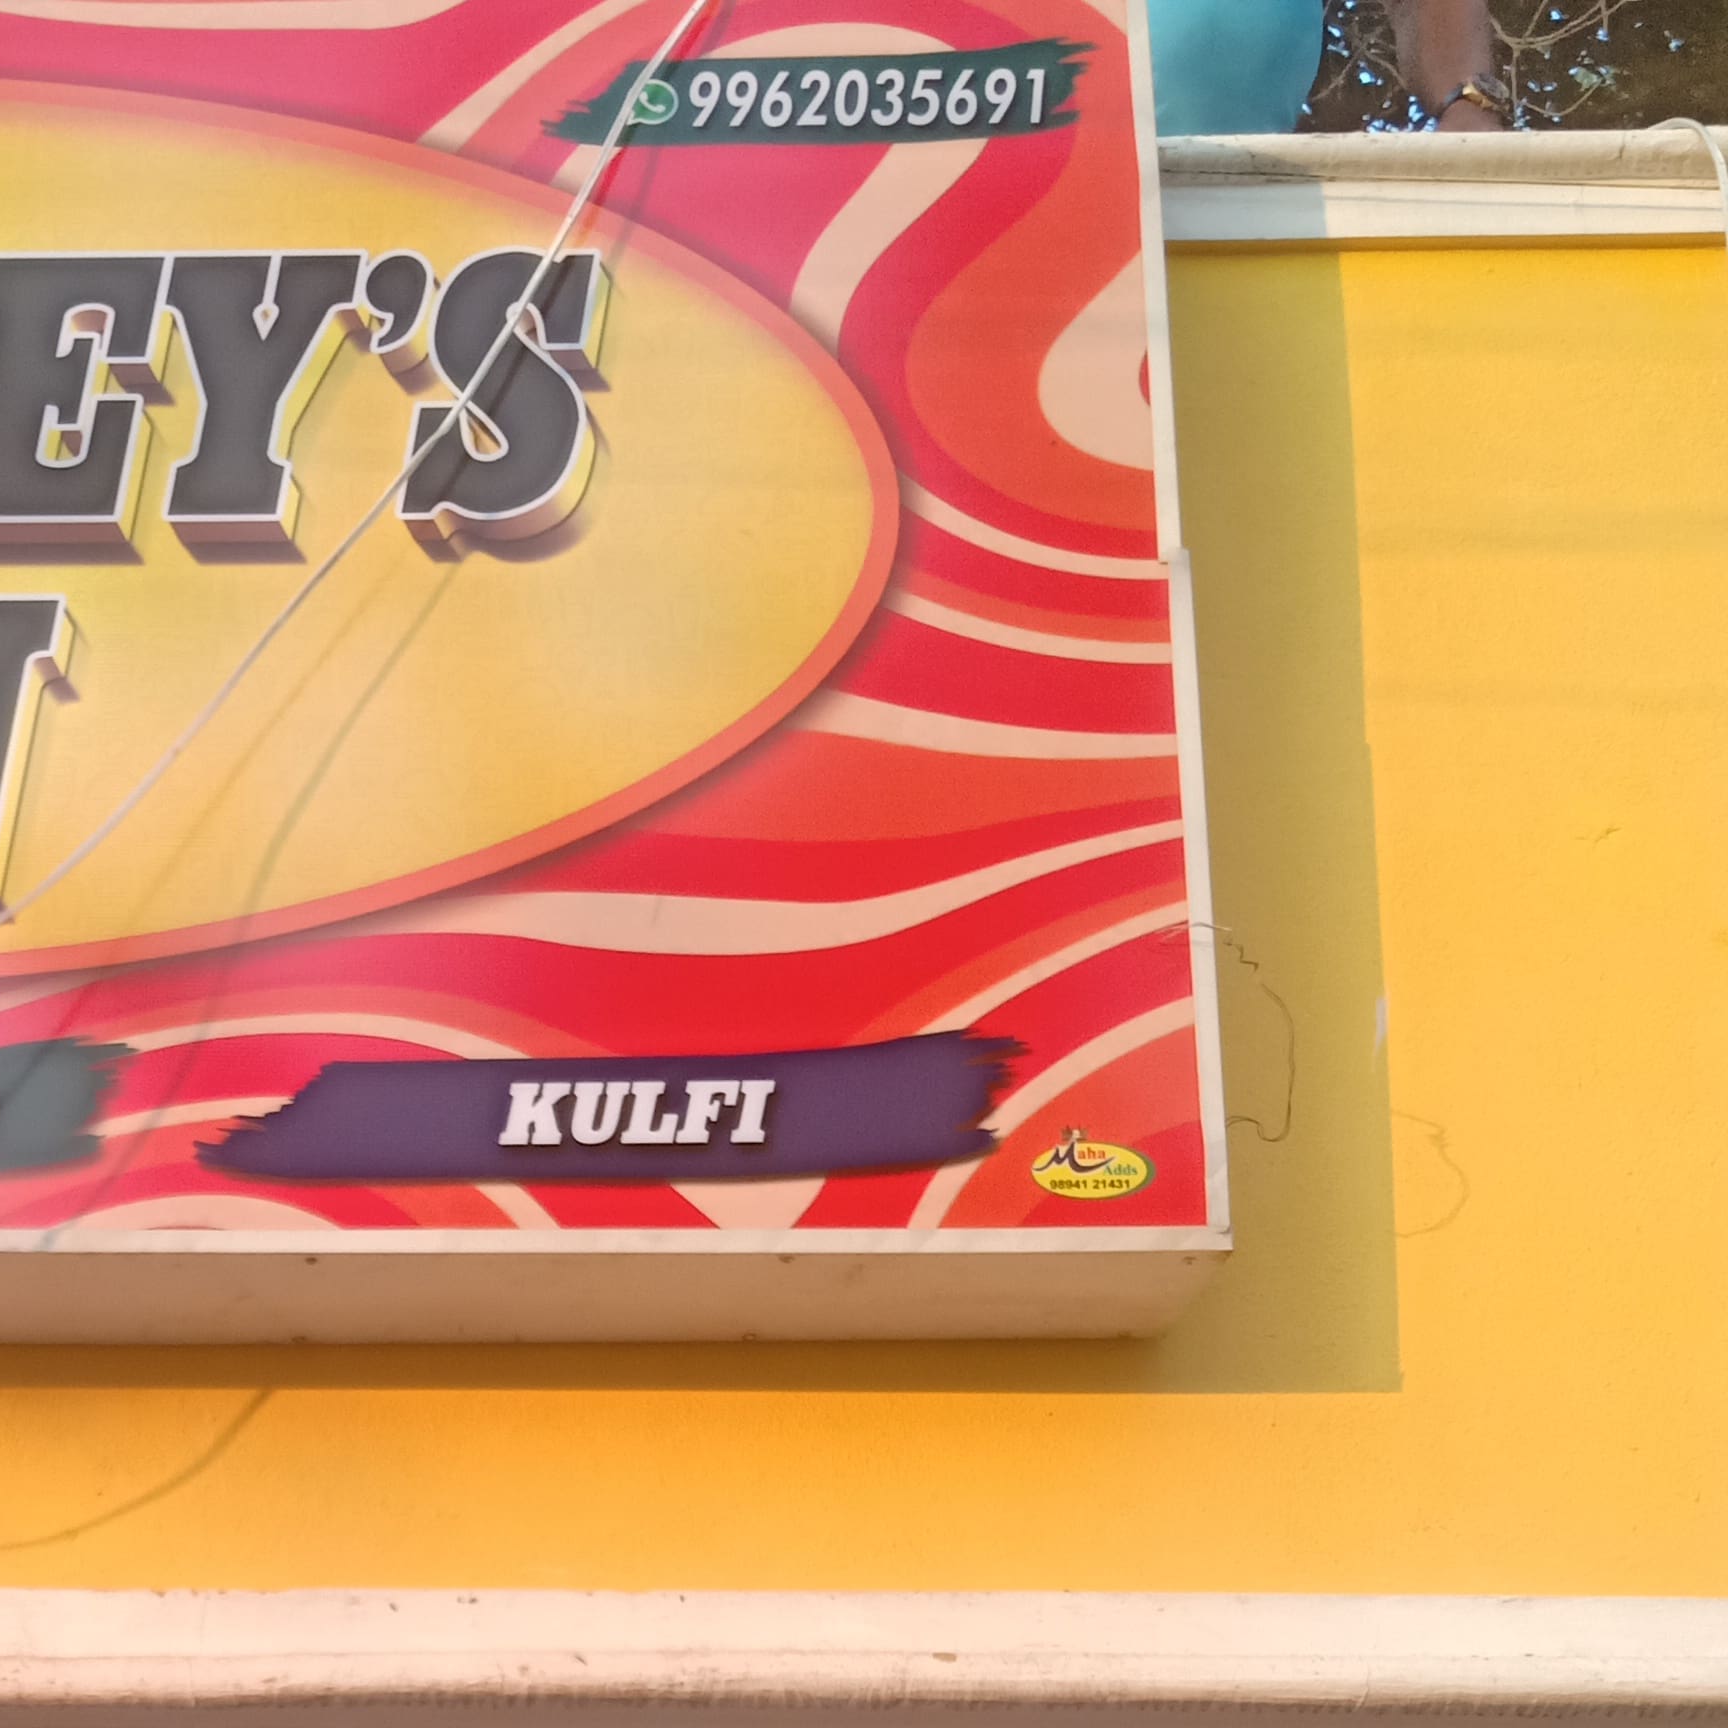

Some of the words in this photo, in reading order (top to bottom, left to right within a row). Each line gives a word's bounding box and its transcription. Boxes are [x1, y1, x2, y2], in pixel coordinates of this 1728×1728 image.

[688, 68, 1047, 127] 9962035691
[498, 1079, 776, 1146] KULFI
[1049, 1179, 1088, 1190] 98941
[1092, 1179, 1130, 1190] 21431
[1103, 1164, 1138, 1176] Adds
